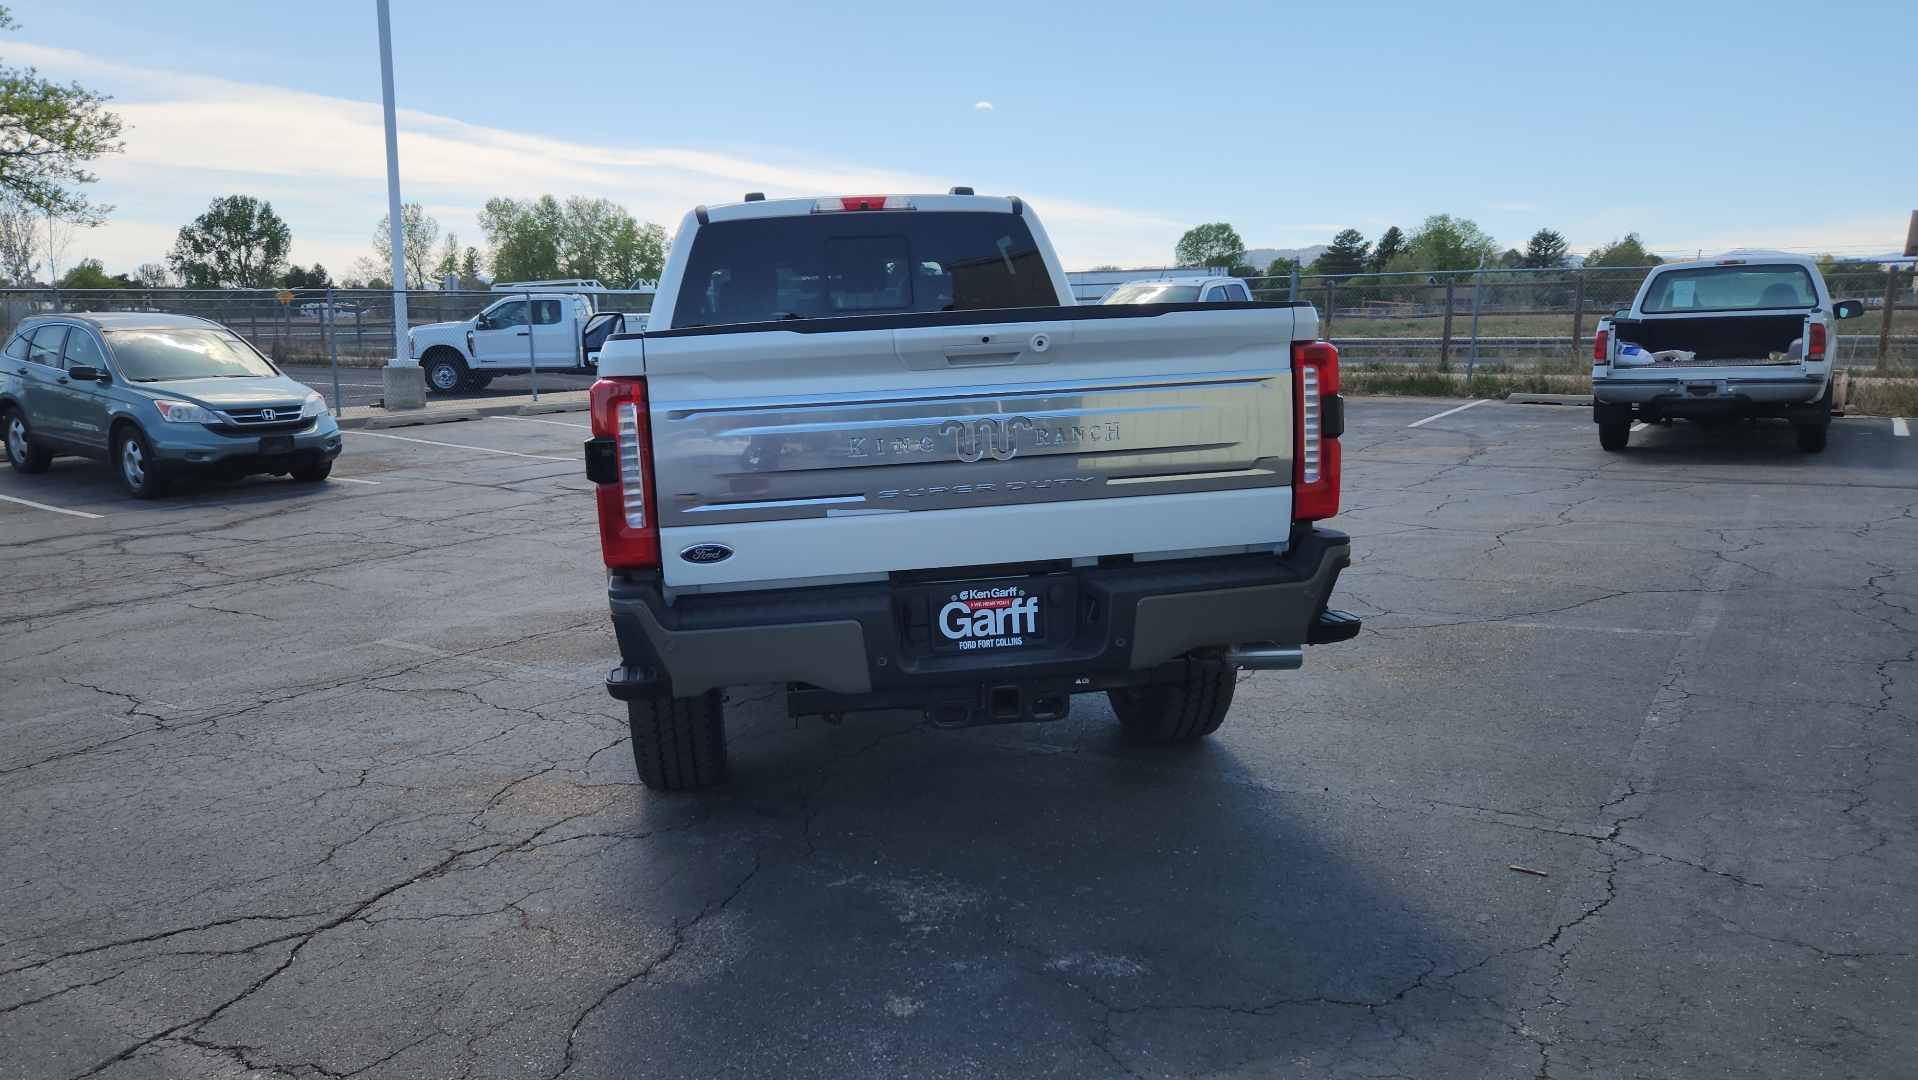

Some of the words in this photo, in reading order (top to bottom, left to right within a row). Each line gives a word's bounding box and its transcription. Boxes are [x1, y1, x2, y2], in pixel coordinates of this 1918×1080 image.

[848, 436, 934, 457] KING
[1035, 422, 1121, 446] RANCH
[878, 482, 998, 500] SUPER
[1005, 476, 1095, 491] DUTY
[693, 548, 721, 559] Ford
[969, 589, 990, 600] Ken
[991, 587, 1017, 598] Garff
[939, 597, 1038, 639] Garff
[959, 641, 976, 650] FORD
[977, 639, 995, 649] FORT
[995, 637, 1022, 647] COLLINS
